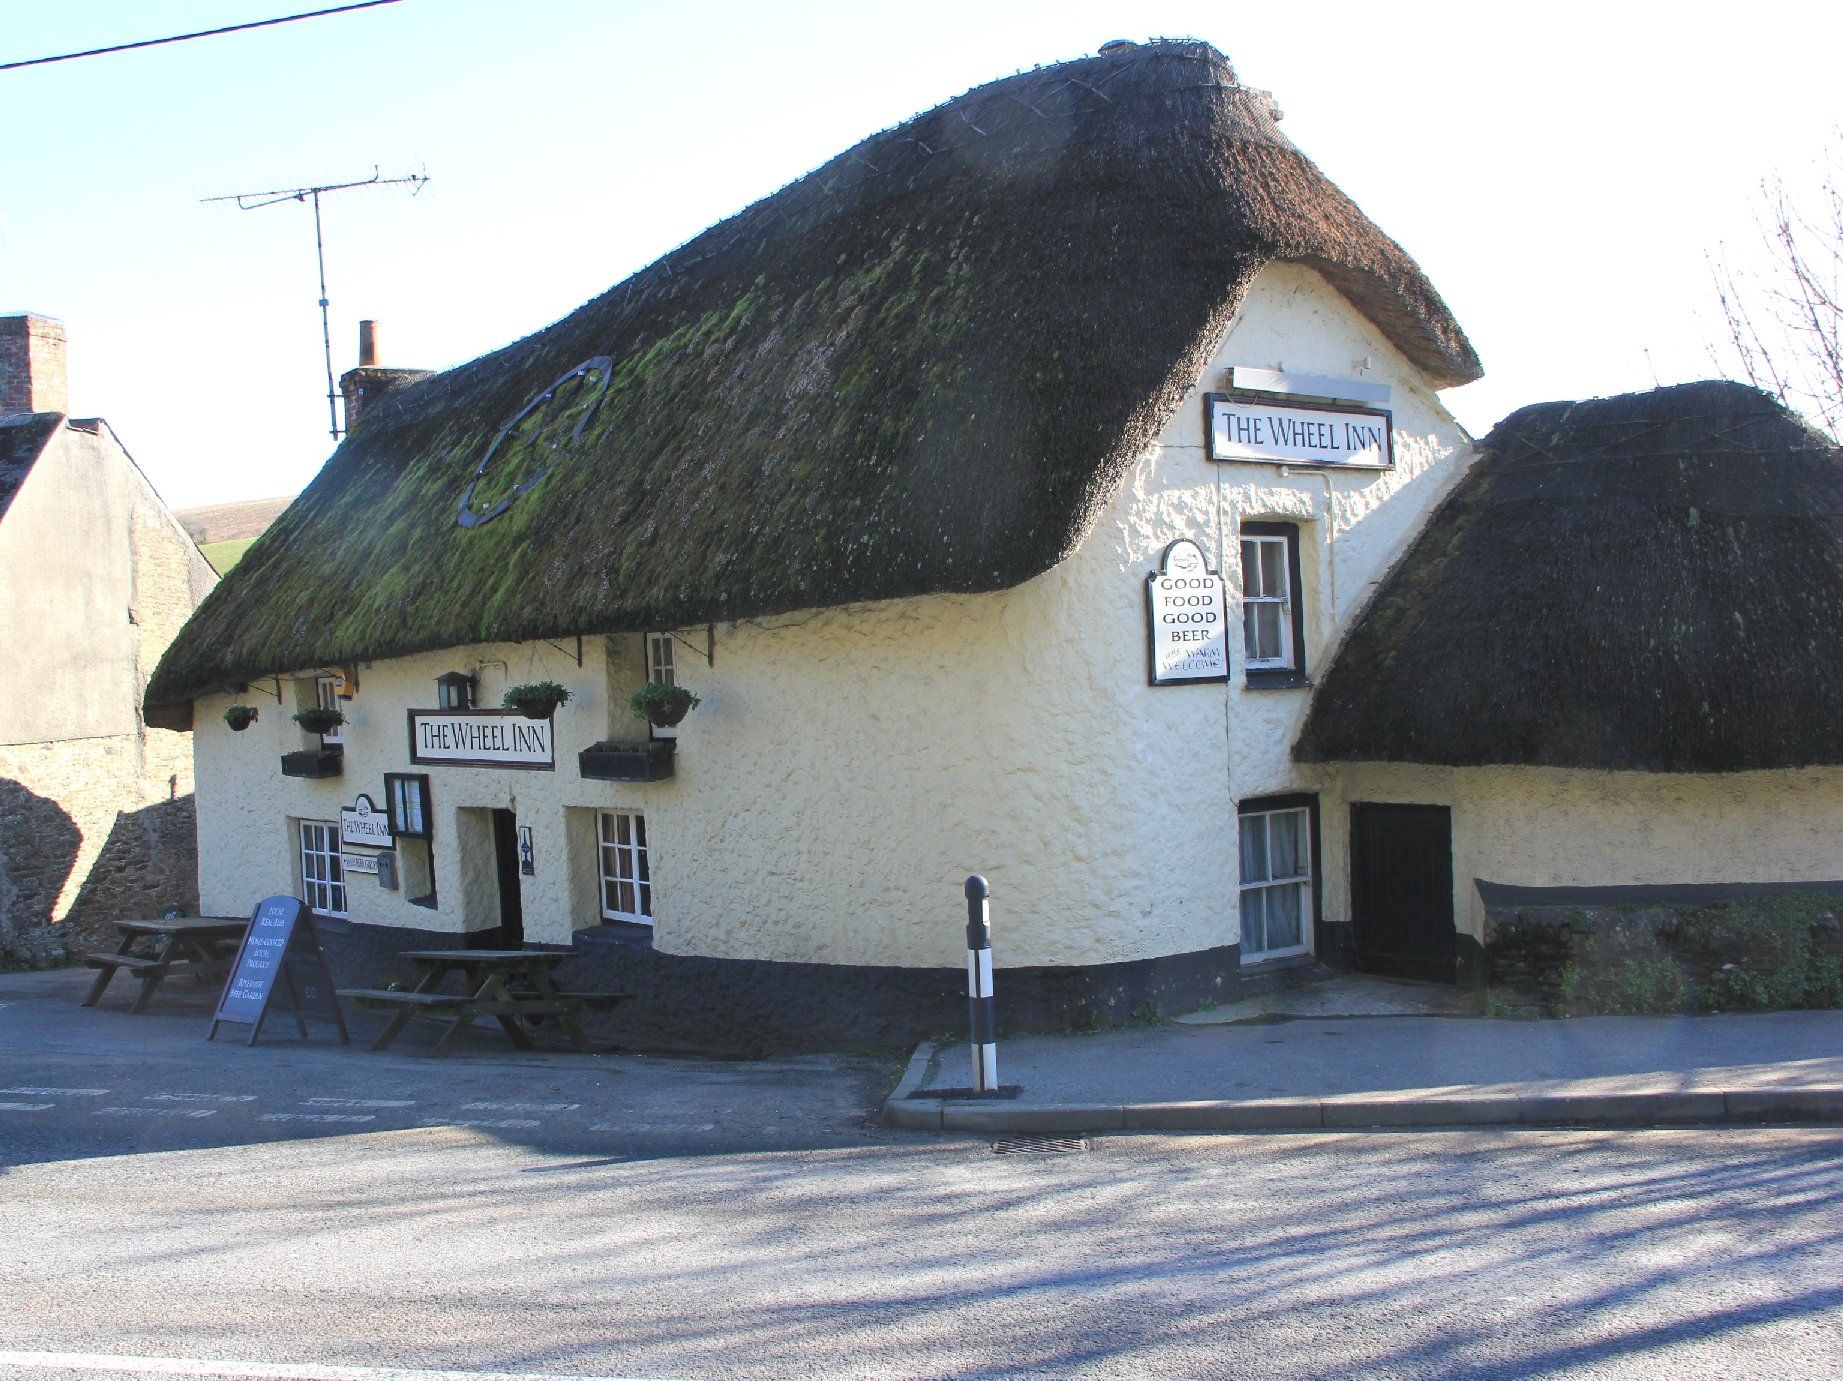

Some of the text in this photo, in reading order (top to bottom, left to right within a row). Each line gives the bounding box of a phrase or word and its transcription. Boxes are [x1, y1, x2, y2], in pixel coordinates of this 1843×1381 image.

[1222, 412, 1382, 452] THE WHEEL INN
[1161, 578, 1214, 590] GOOD
[1164, 595, 1213, 607] FOOD
[1163, 612, 1217, 624] GOOD
[1171, 629, 1211, 642] BEER
[420, 722, 546, 752] THE WHEEL INN
[343, 818, 354, 833] THE
[354, 820, 375, 836] WHEEL
